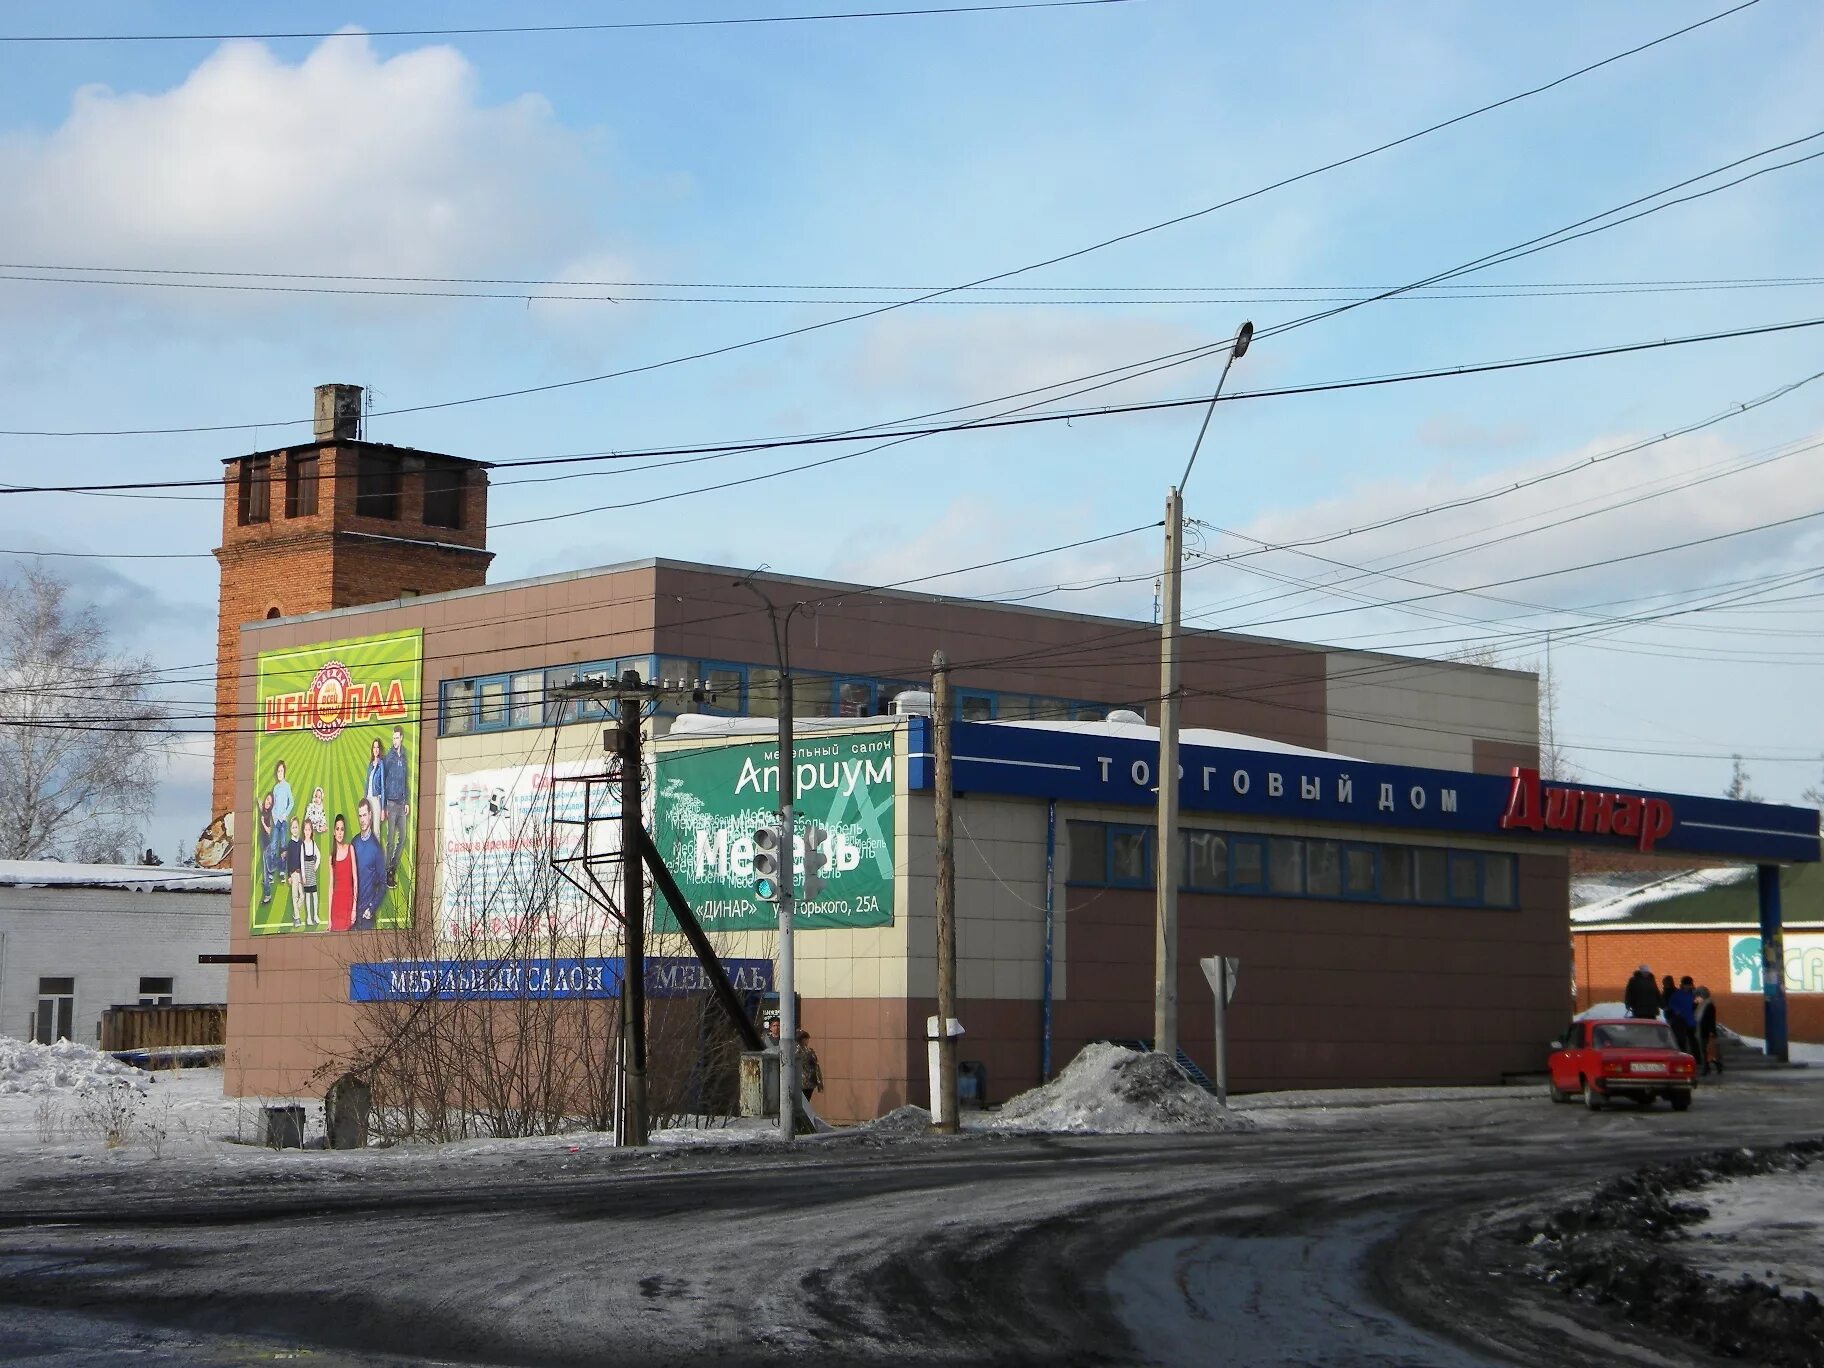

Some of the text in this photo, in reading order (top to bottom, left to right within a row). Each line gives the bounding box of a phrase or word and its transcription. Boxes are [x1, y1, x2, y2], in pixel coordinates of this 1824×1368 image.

[764, 744, 839, 761] меельный
[1378, 783, 1458, 814] ДОМ
[1501, 766, 1674, 853] Динар
[856, 895, 880, 913] 25А
[527, 966, 603, 991] САЛОН
